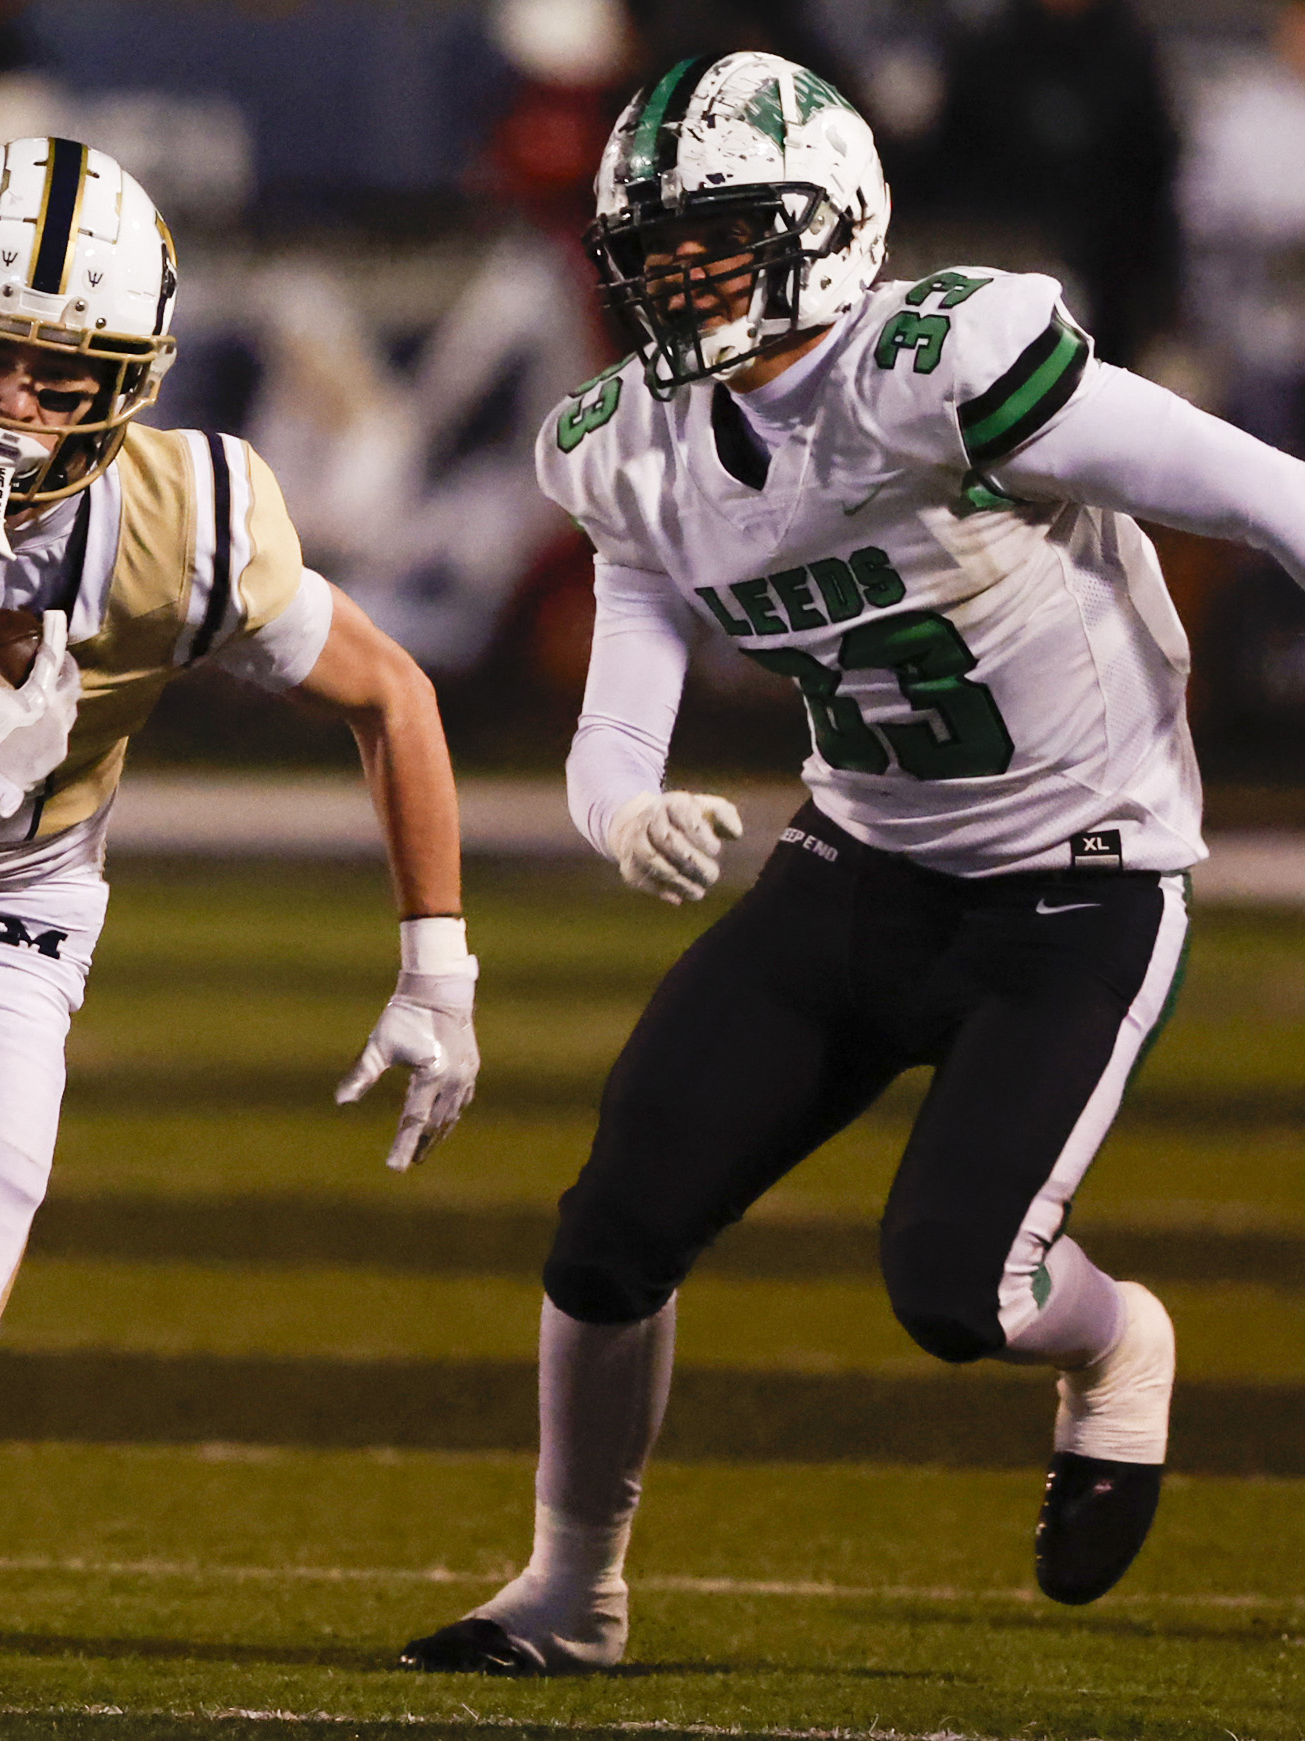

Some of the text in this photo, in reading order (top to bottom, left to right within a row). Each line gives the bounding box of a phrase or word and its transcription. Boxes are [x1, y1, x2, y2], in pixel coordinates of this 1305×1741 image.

[873, 271, 994, 375] 33
[556, 350, 637, 454] 3
[694, 546, 907, 637] LEEDS
[802, 834, 839, 862] END
[1082, 836, 1110, 852] XL
